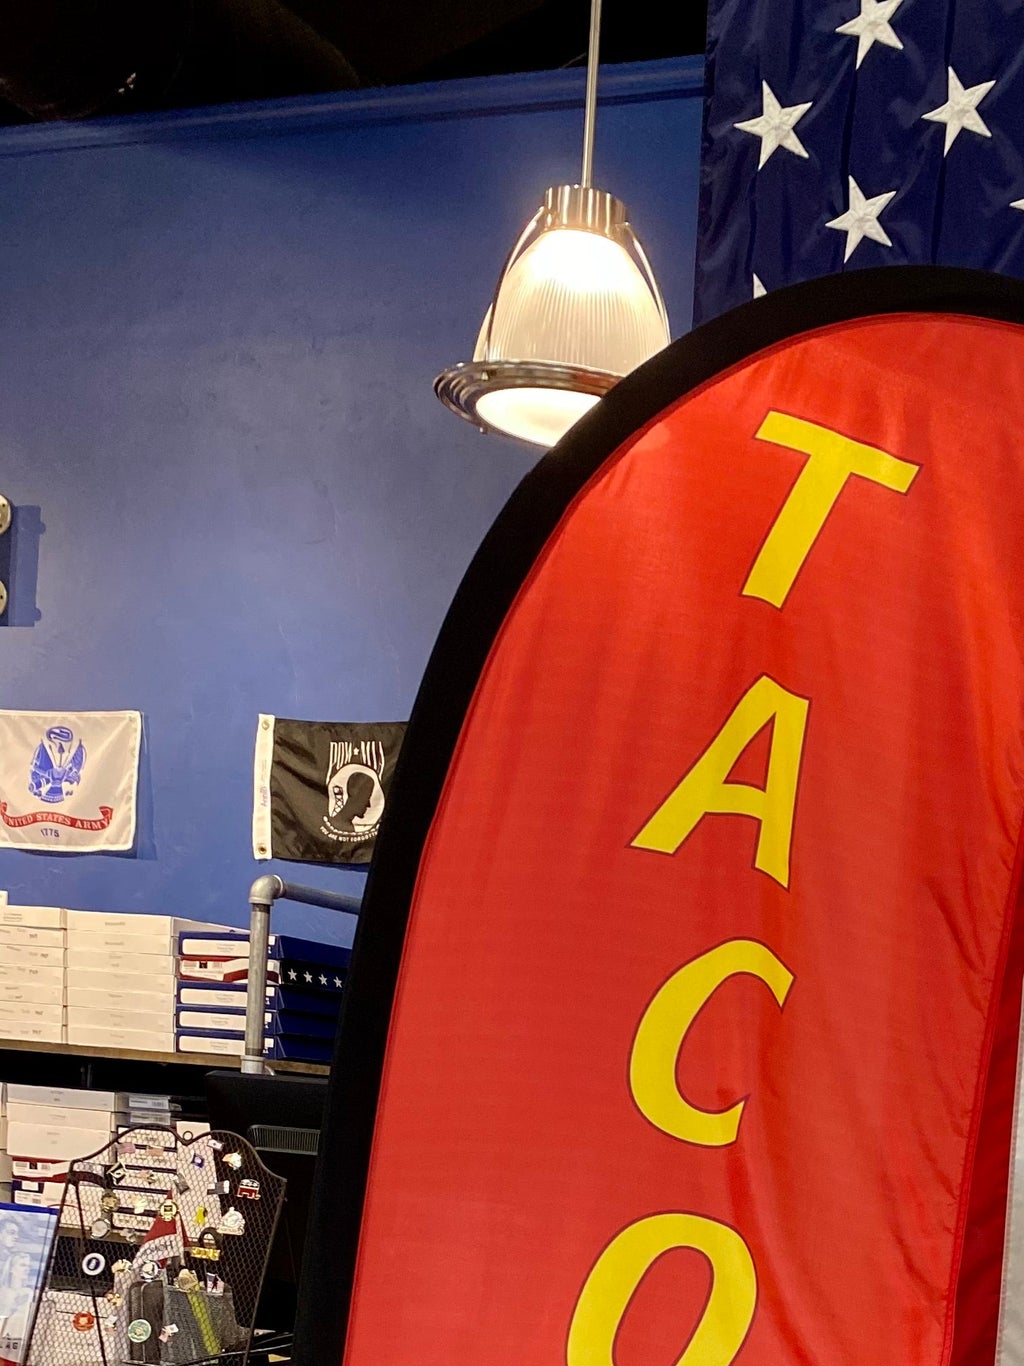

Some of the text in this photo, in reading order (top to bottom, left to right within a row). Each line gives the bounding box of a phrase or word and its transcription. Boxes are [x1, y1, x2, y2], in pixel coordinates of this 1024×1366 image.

[326, 741, 352, 784] POW
[3, 812, 109, 830] UNITED STATES ARMY
[40, 828, 60, 838] 1775
